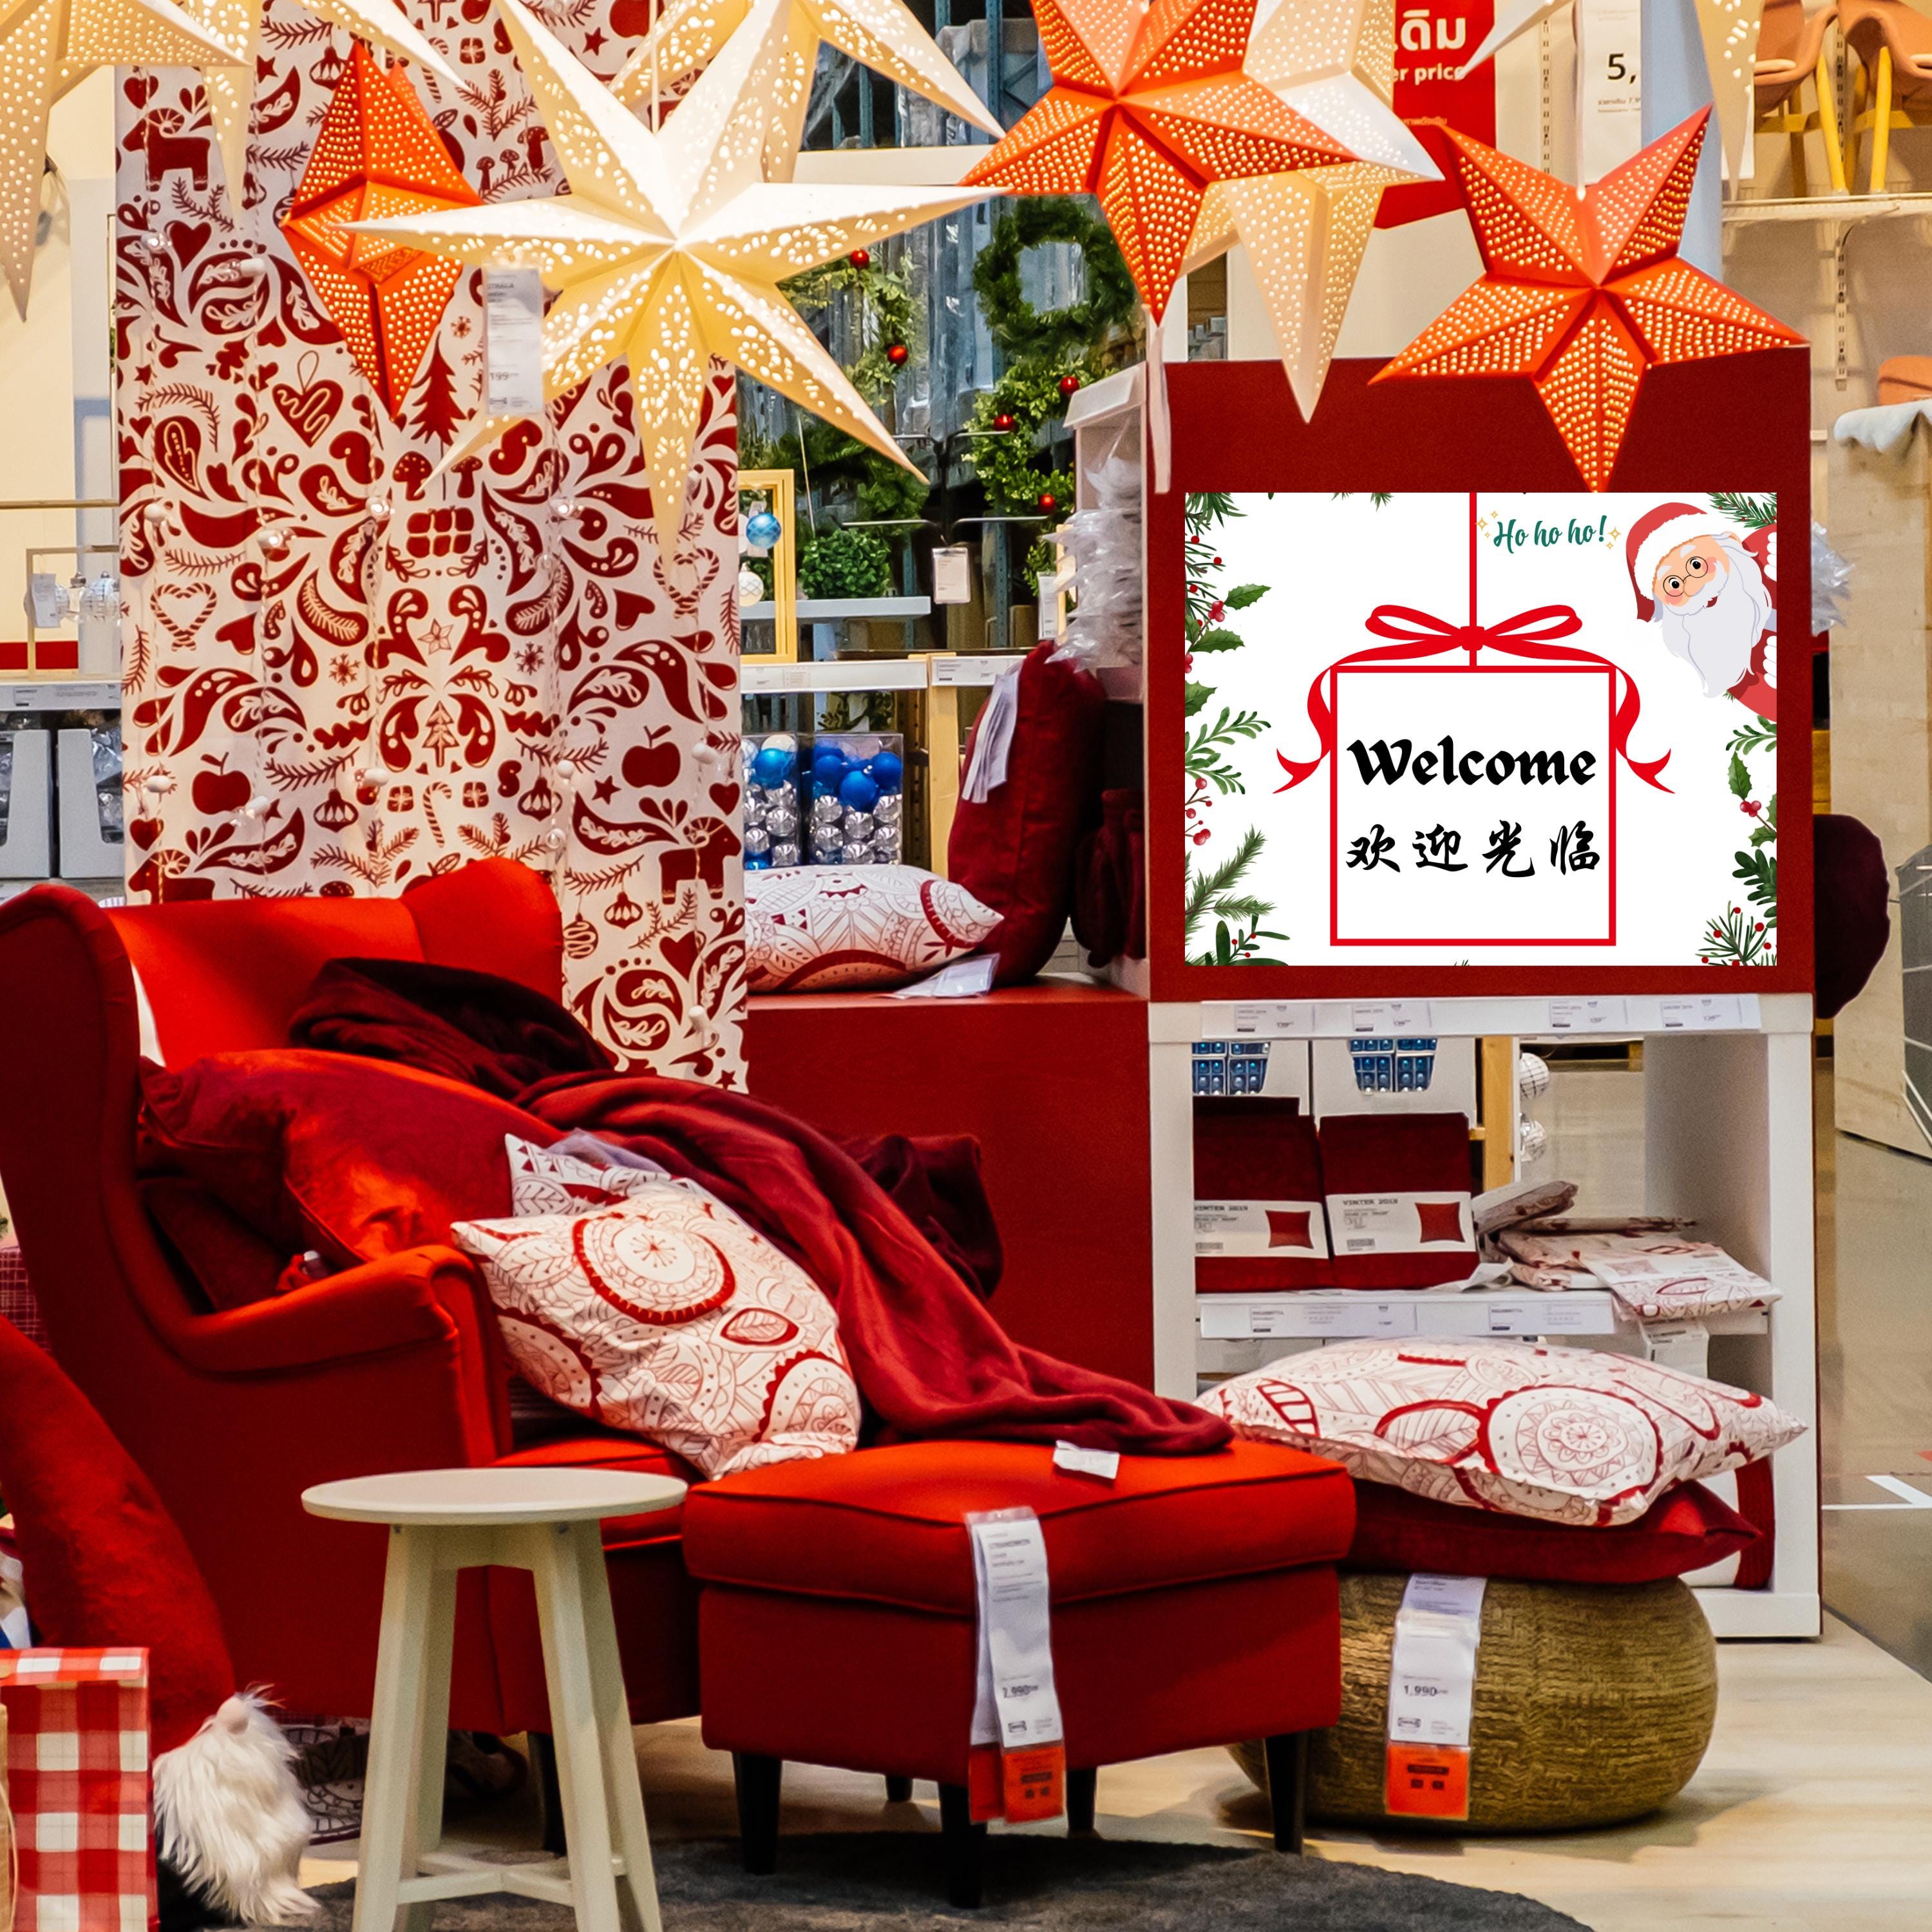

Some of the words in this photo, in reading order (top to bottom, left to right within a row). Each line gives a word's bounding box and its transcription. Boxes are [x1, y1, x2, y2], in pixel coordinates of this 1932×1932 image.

[1607, 52, 1636, 84] 5,
[1493, 519, 1529, 554] Ho
[1534, 520, 1563, 547] ho
[1568, 515, 1607, 545] ho!
[1346, 735, 1596, 785] Welcome
[1346, 820, 1600, 878] 欢迎光临
